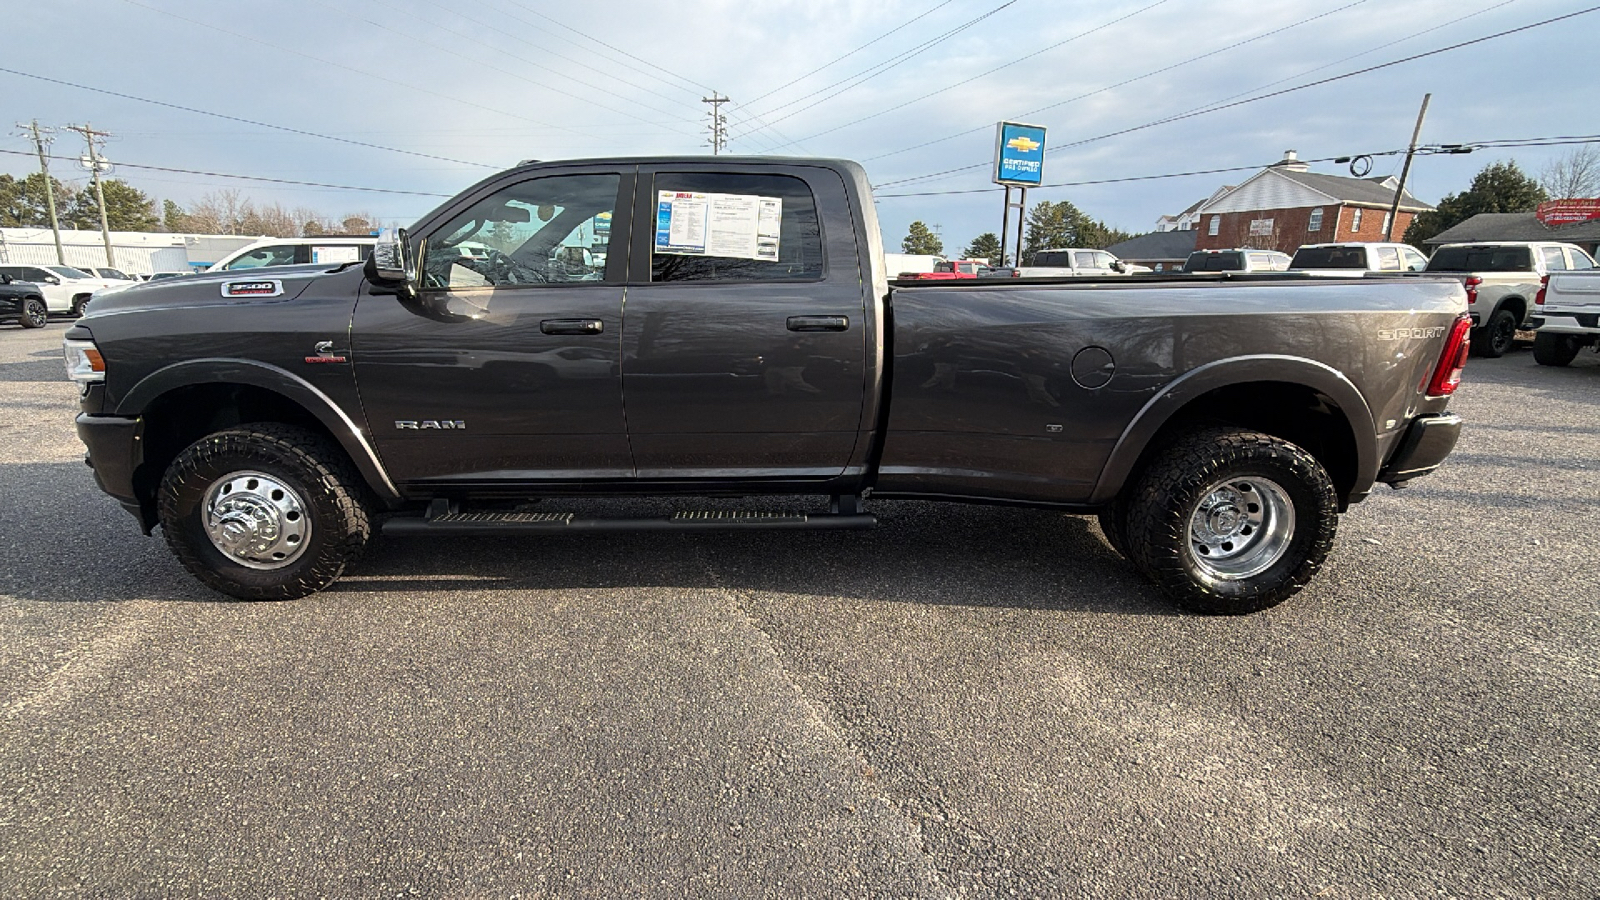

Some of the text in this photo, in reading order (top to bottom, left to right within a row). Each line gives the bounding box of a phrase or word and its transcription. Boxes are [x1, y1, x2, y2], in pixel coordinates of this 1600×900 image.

[1003, 158, 1040, 168] CERTIFIED
[1377, 326, 1446, 341] SPORT
[394, 420, 466, 430] RAM
